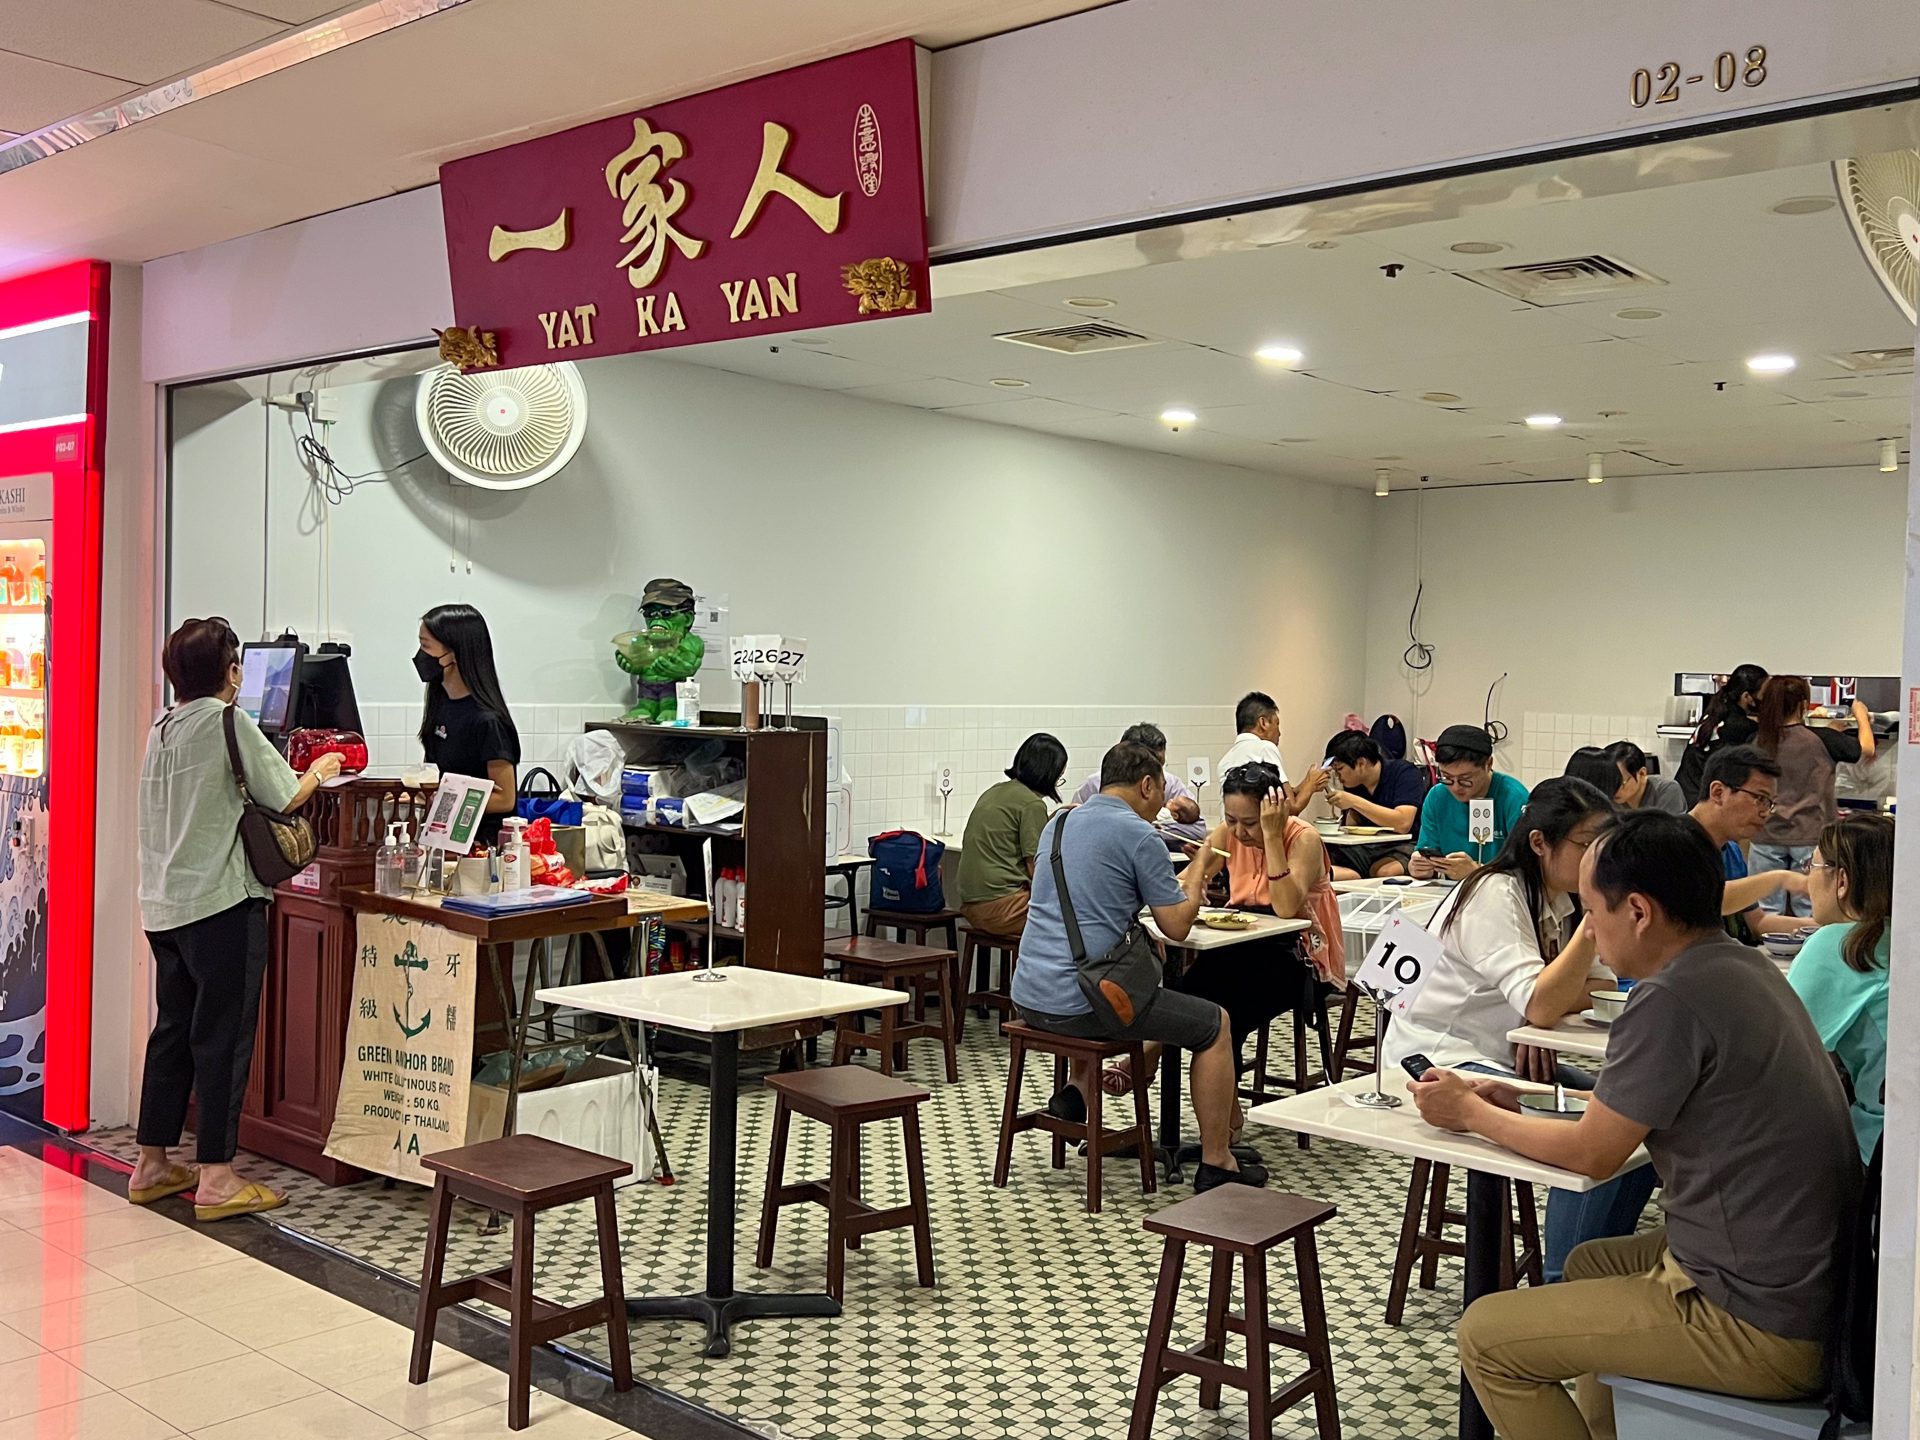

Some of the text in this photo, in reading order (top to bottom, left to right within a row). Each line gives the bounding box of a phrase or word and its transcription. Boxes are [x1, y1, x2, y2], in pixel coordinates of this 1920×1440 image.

[1629, 45, 1767, 108] 02-08
[488, 116, 844, 289] 一家人
[538, 272, 799, 350] YAT KA YAN
[778, 650, 804, 667] 27
[1377, 941, 1421, 985] 10
[358, 1045, 392, 1065] GREEN
[363, 1070, 393, 1084] WHITE
[413, 1097, 425, 1110] 50
[413, 1114, 450, 1133] THAILAND
